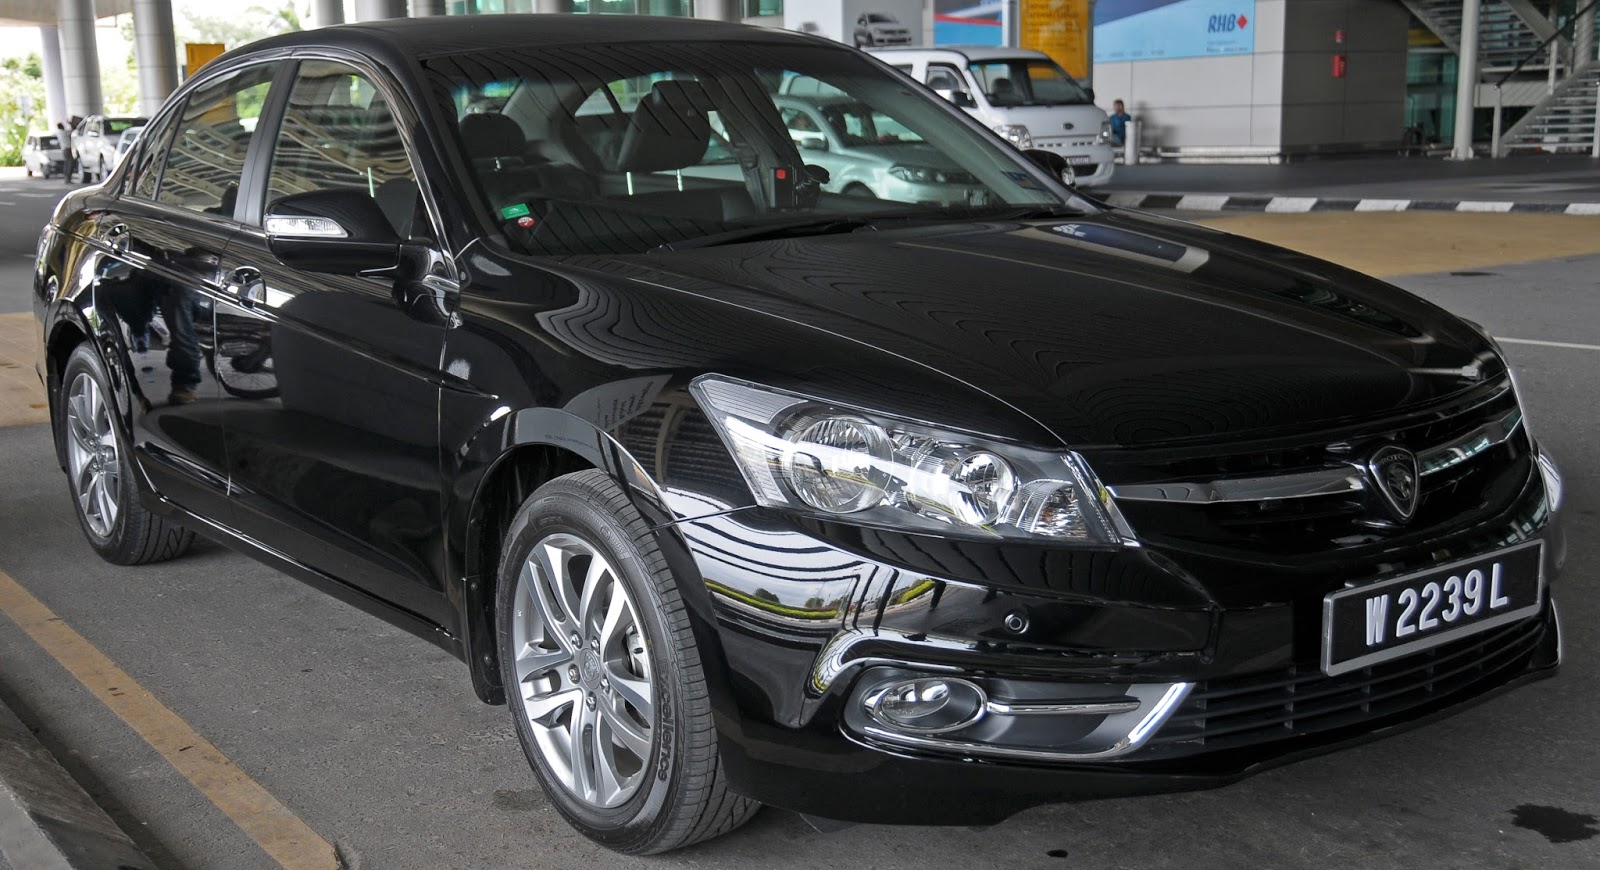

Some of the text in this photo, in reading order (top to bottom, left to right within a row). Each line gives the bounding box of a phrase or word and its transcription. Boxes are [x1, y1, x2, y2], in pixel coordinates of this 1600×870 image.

[1208, 13, 1236, 33] RHB
[1376, 453, 1412, 466] PROTON
[1366, 563, 1508, 646] W 2239 L
